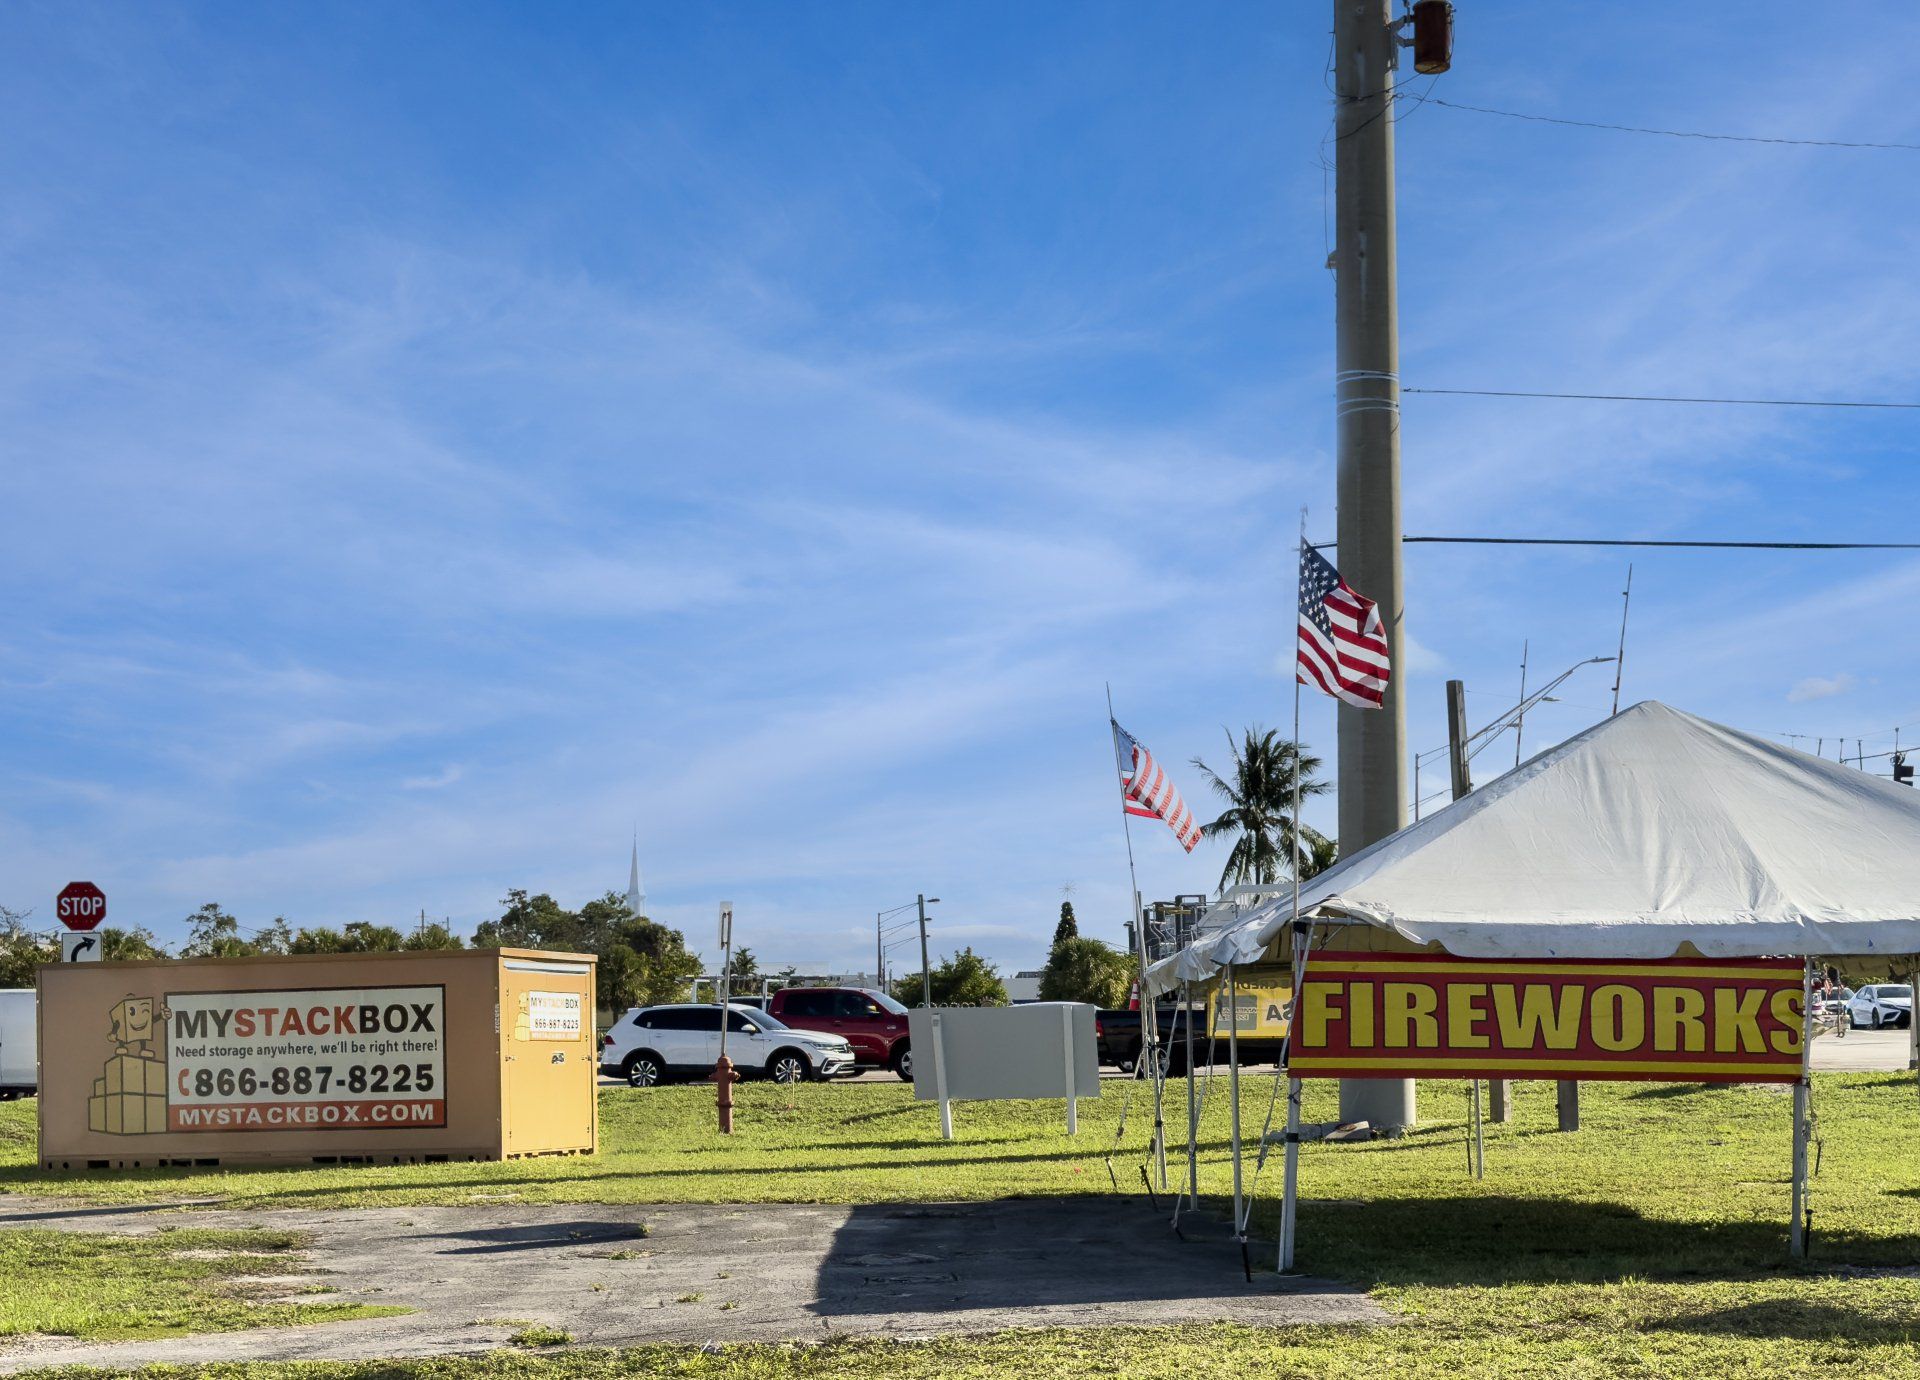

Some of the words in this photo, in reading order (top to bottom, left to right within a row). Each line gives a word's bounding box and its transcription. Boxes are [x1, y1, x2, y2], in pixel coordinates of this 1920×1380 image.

[60, 896, 103, 916] STOP
[175, 1003, 435, 1039] MYSTACKBOX
[535, 1019, 579, 1029] 866-887-8225
[1302, 982, 1804, 1054] FIREWORKS
[175, 1045, 206, 1058] Need
[209, 1044, 253, 1059] storage
[256, 1042, 317, 1058] anywhere,
[320, 1041, 348, 1054] we'll
[351, 1041, 366, 1053] be
[369, 1040, 399, 1055] right
[402, 1039, 438, 1052] there!
[195, 1063, 434, 1097] 866-887-8225
[179, 1103, 434, 1126] MYSTACKBOX.COM
